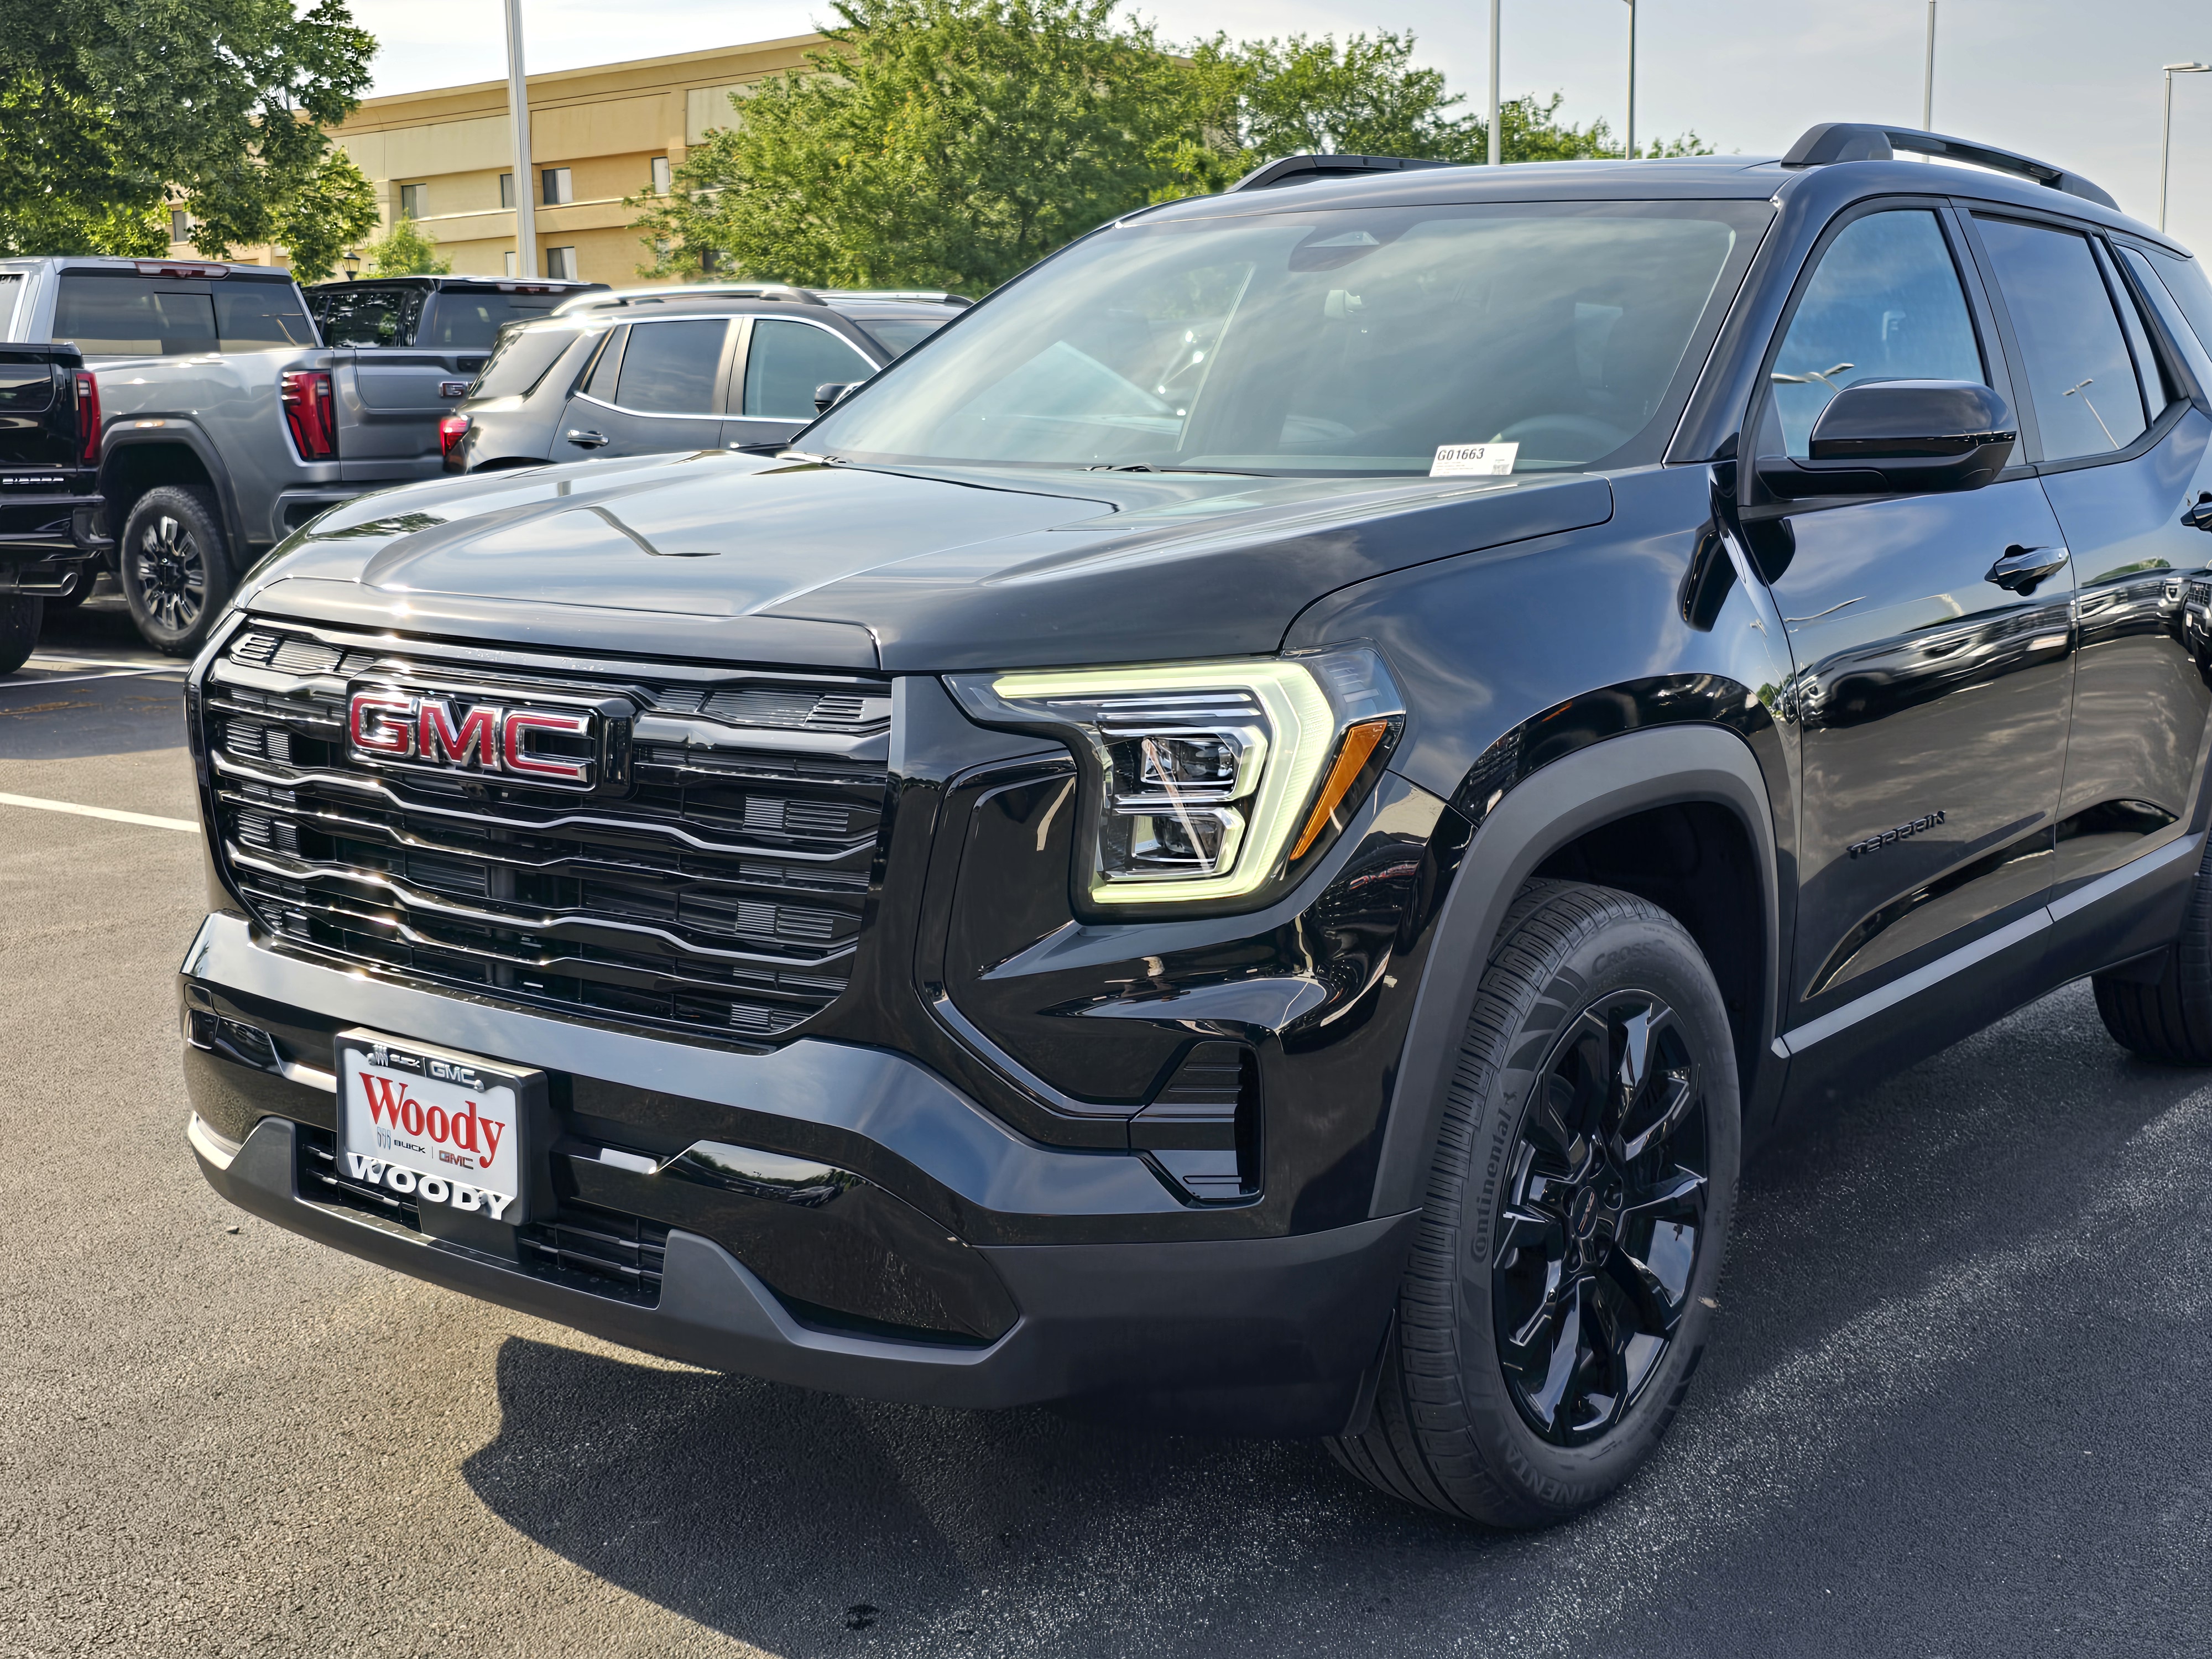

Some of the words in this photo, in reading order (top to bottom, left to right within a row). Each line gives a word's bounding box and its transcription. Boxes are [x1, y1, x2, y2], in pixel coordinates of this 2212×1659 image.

[1437, 447, 1485, 461] G01663
[351, 690, 590, 784] GMC
[1846, 810, 1947, 859] TERRAIN
[430, 1061, 476, 1085] GMC
[358, 1071, 505, 1168] Woody
[394, 1139, 426, 1154] BUICK
[439, 1150, 474, 1170] GMC
[347, 1152, 514, 1220] WOODY
[1469, 1107, 1512, 1264] Continental
